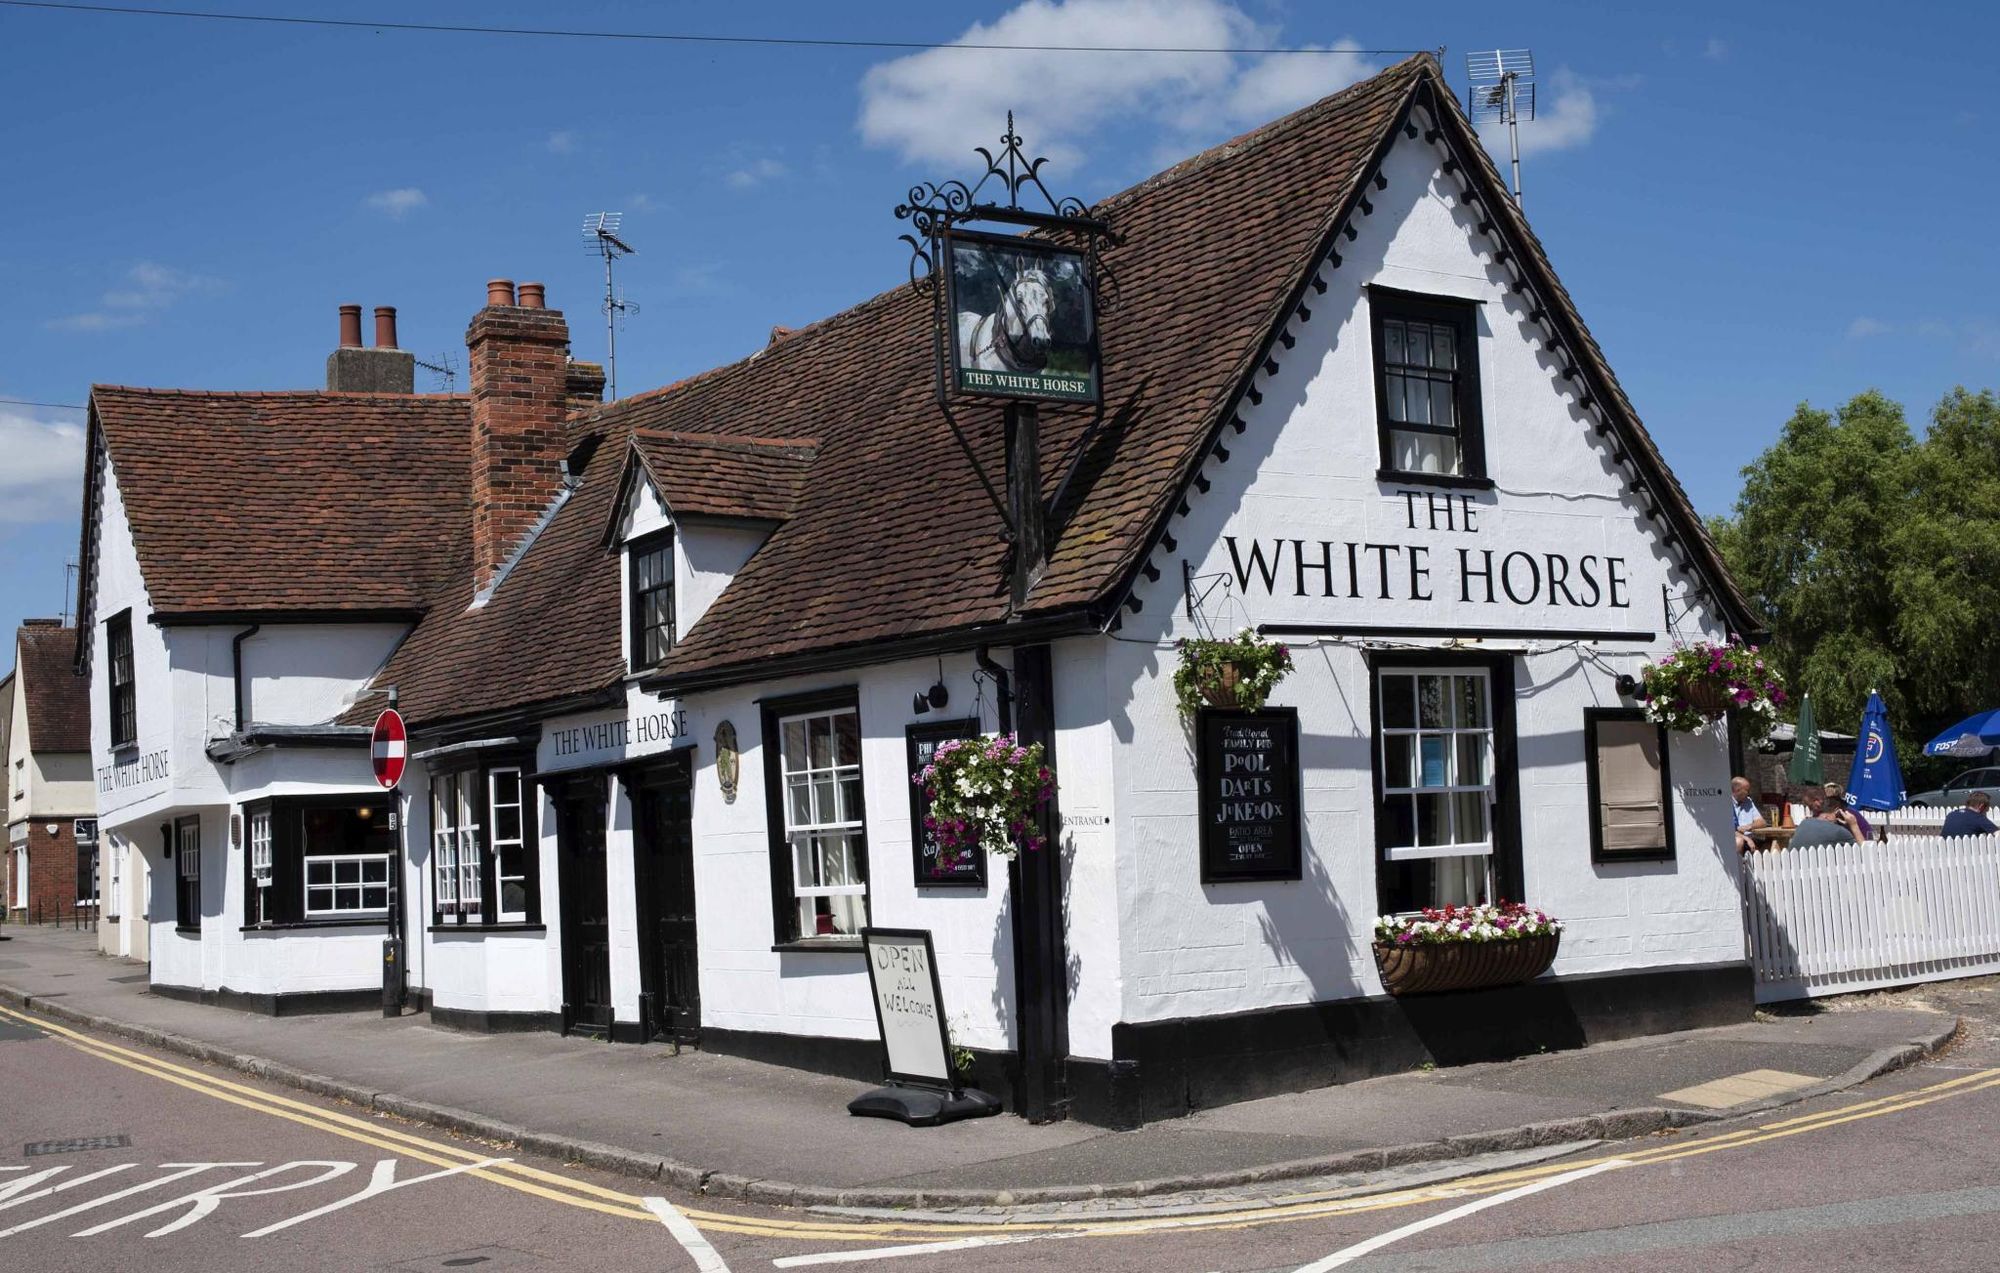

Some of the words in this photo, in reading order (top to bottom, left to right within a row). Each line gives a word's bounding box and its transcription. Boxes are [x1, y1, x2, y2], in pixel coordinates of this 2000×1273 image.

[966, 372, 993, 386] THE
[995, 375, 1040, 390] WHITE
[1043, 378, 1086, 393] HORSE
[1396, 489, 1479, 533] THE
[1222, 536, 1433, 601] WHITE
[1456, 547, 1631, 609] HORSE
[552, 727, 580, 756] THE
[582, 719, 633, 750] WHITE
[636, 710, 689, 744] HORSE
[97, 766, 113, 793] THE
[113, 759, 140, 790] WHITE
[141, 750, 169, 783] HORSE
[1224, 753, 1272, 773] POOL
[1220, 777, 1273, 798] DARTS
[1063, 816, 1104, 826] ENTRANCE
[1216, 801, 1284, 823] JUKEBOX
[1238, 844, 1263, 854] OPEN
[877, 946, 924, 973] OPEN
[897, 976, 916, 991] ALL
[883, 993, 934, 1019] WELCOME
[0, 1157, 515, 1238] NTRY
